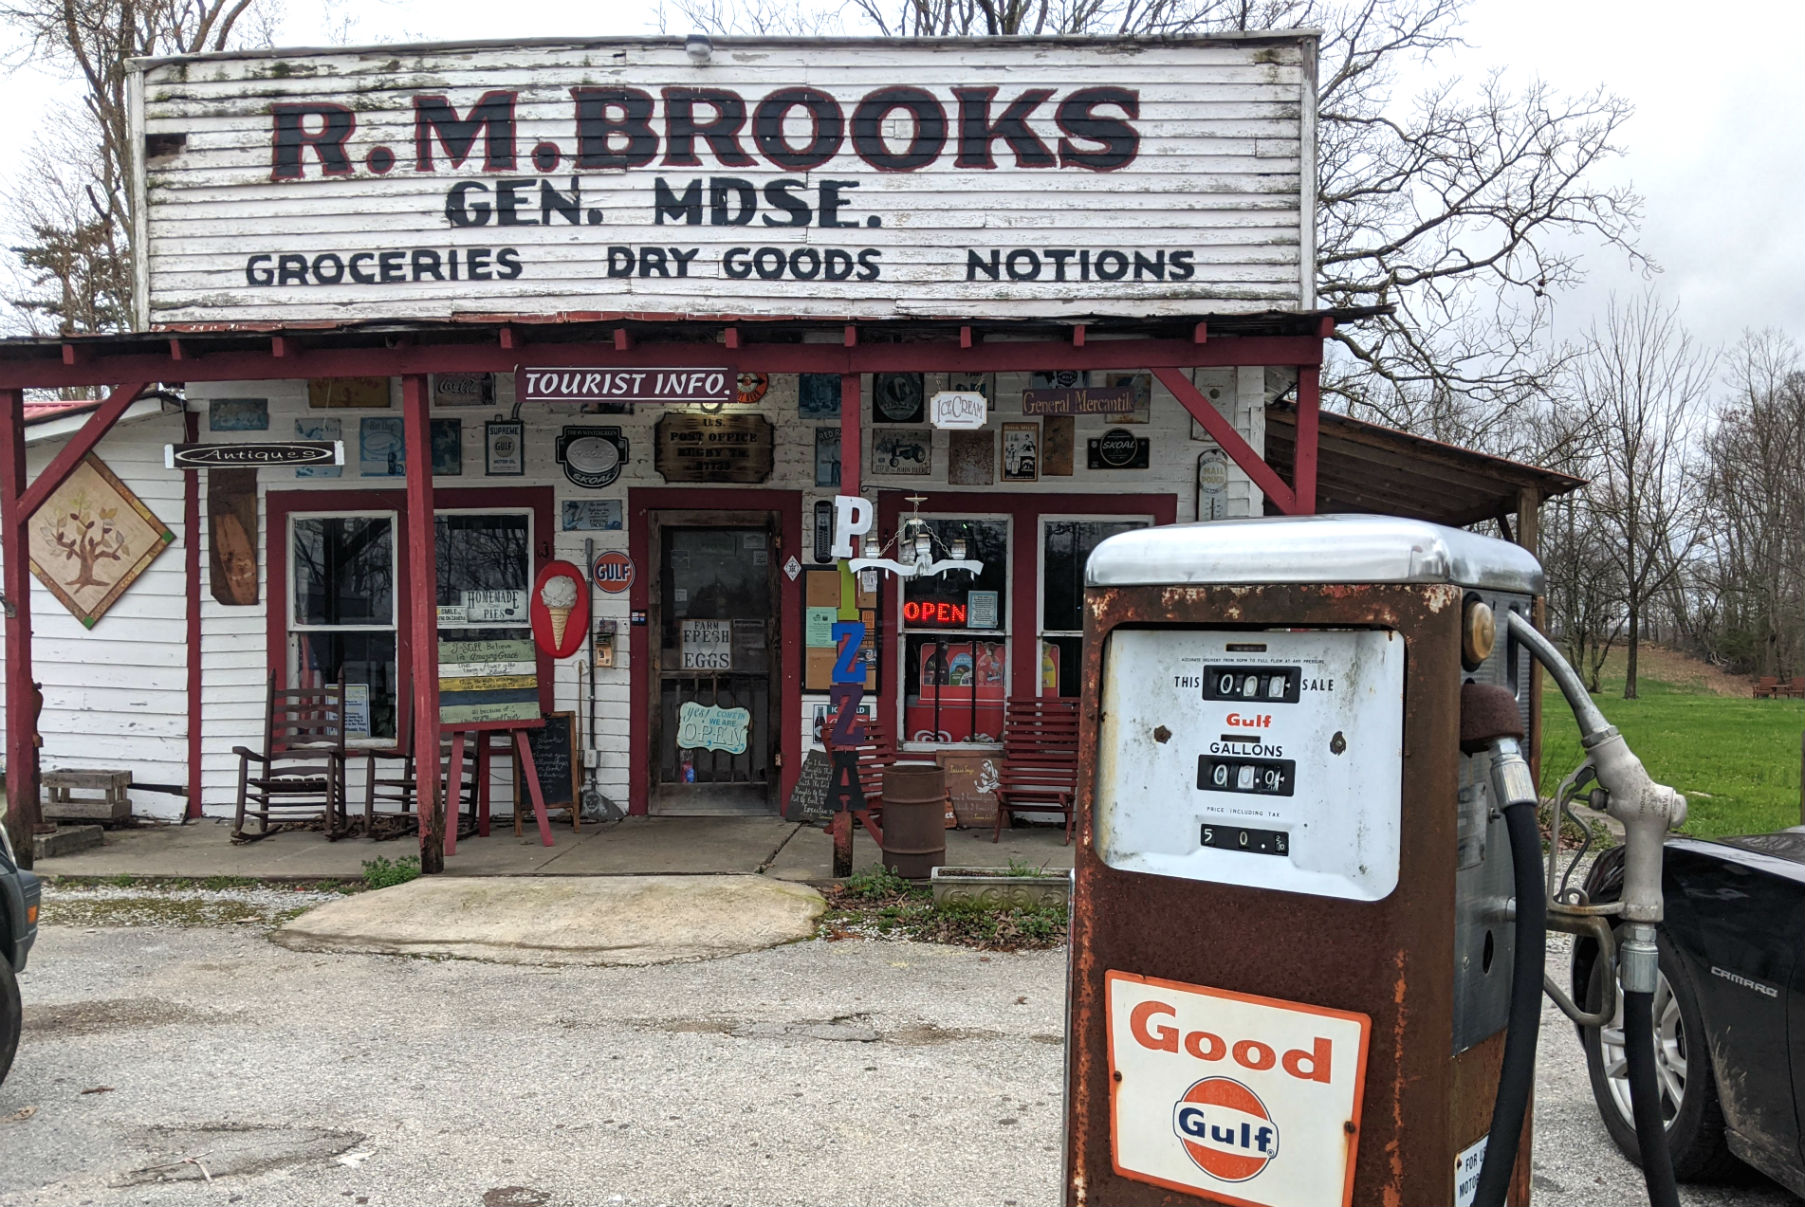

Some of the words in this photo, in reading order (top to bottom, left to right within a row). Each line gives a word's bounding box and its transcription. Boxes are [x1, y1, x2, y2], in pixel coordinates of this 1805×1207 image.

[444, 175, 604, 228] GEN.
[654, 177, 882, 229] MDSE.
[245, 247, 523, 286] GROCERIES
[607, 245, 700, 279] DRY
[723, 247, 881, 281] GOODS
[966, 248, 1195, 281] NOTIONS
[525, 372, 647, 394] TOURIST
[654, 372, 731, 395] INFO.
[937, 398, 953, 423] ICE
[952, 395, 984, 419] CREAM
[1023, 391, 1070, 414] General
[1074, 390, 1135, 413] Mercantile
[489, 426, 520, 435] SUPREME
[670, 431, 705, 441] POST
[709, 432, 758, 442] OFFICE
[495, 441, 513, 451] GULF
[1103, 440, 1135, 449] SKOAL
[190, 448, 317, 461] Antiques
[573, 472, 612, 485] SKOAL
[596, 563, 631, 582] GULF
[468, 591, 520, 609] HOMEMADE
[484, 609, 506, 619] PIES
[903, 601, 966, 622] OPEN
[694, 621, 719, 630] FARM
[684, 652, 730, 668] EGGS
[824, 494, 874, 812] PIZZA
[1174, 676, 1200, 689] THIS
[1302, 678, 1334, 691] SALE
[710, 718, 720, 726] WE
[722, 719, 737, 727] ARE
[717, 710, 737, 719] COME
[738, 712, 746, 720] IN
[1226, 713, 1272, 728] Gulf
[1210, 742, 1283, 758] GALLONS
[1229, 809, 1264, 817] INCLUDING
[1711, 966, 1778, 998] CAMARO
[1129, 1000, 1333, 1085] Good
[1178, 1106, 1273, 1153] Gulf
[1465, 1153, 1478, 1173] FOR
